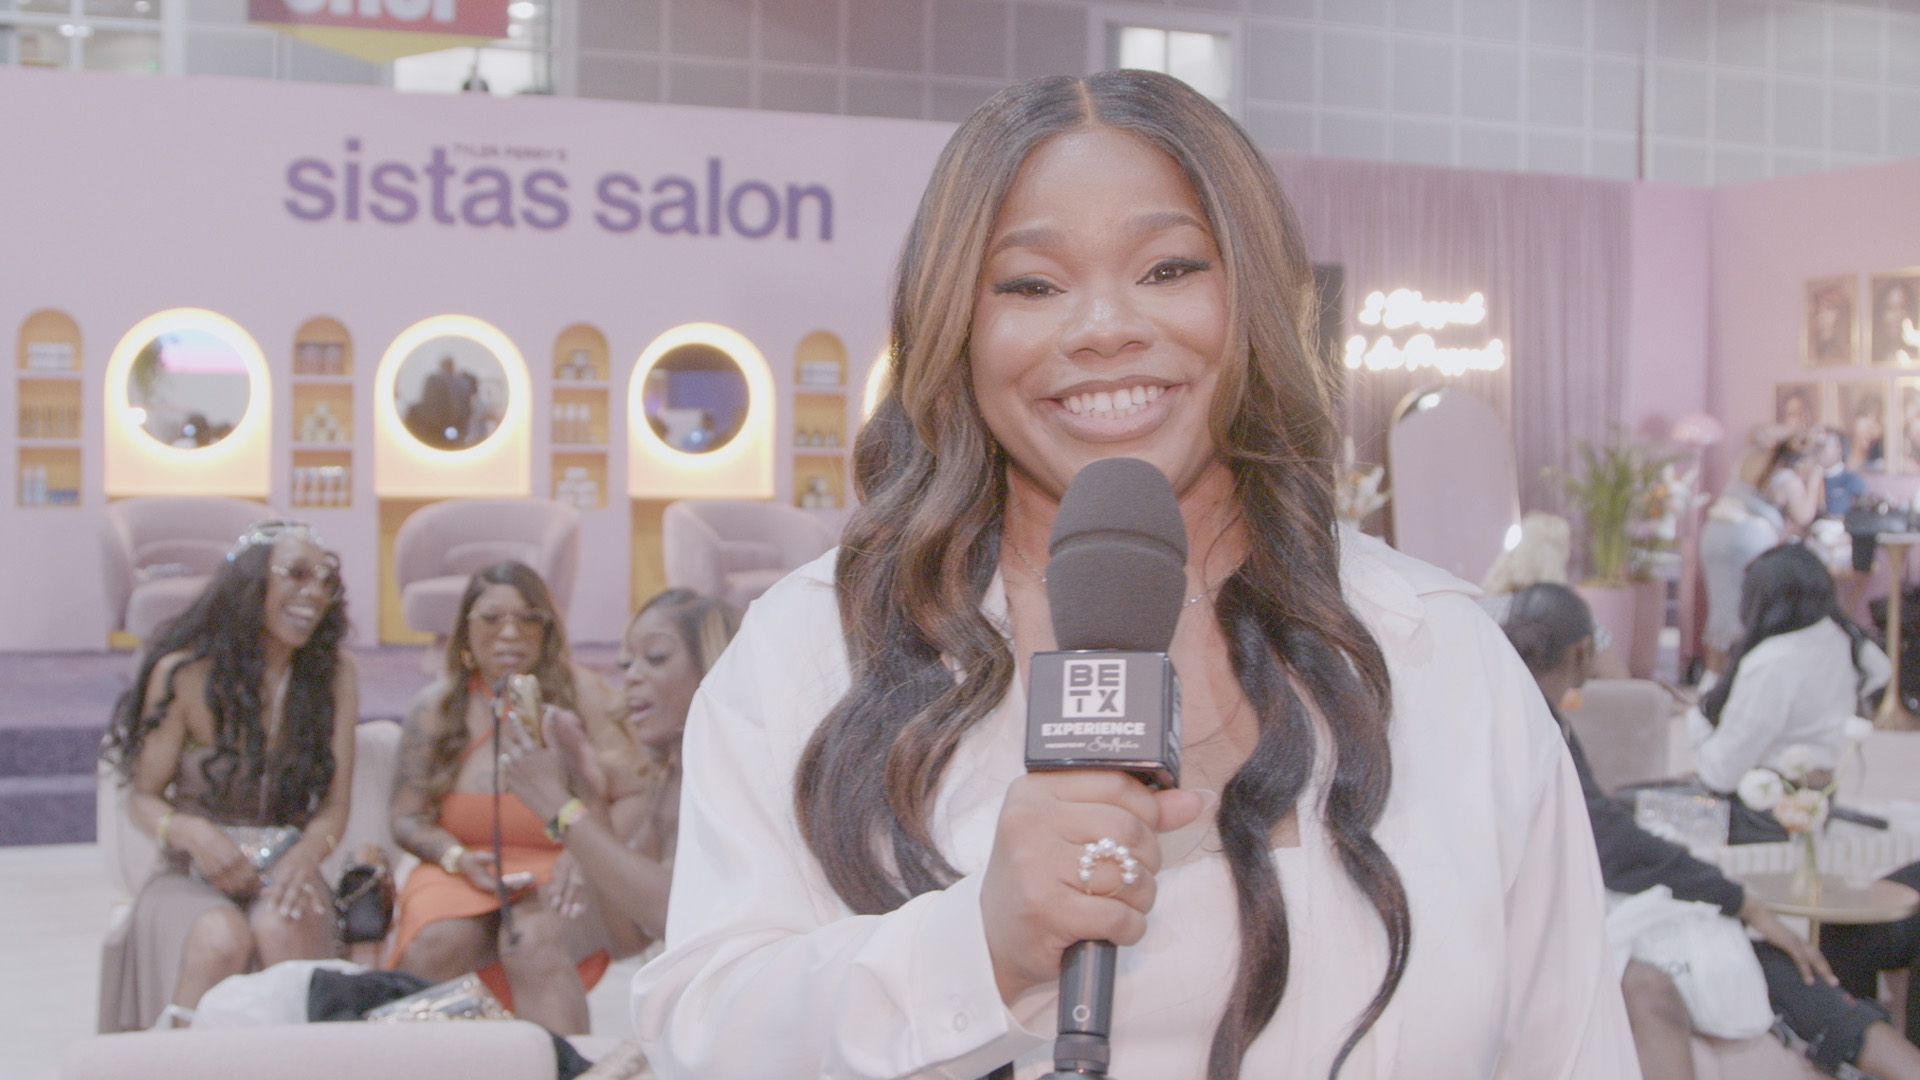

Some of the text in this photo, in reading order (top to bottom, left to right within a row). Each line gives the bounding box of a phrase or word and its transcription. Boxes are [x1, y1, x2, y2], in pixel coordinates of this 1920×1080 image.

[283, 138, 836, 242] sistas salon
[1041, 722, 1146, 737] EXPERIENCE
